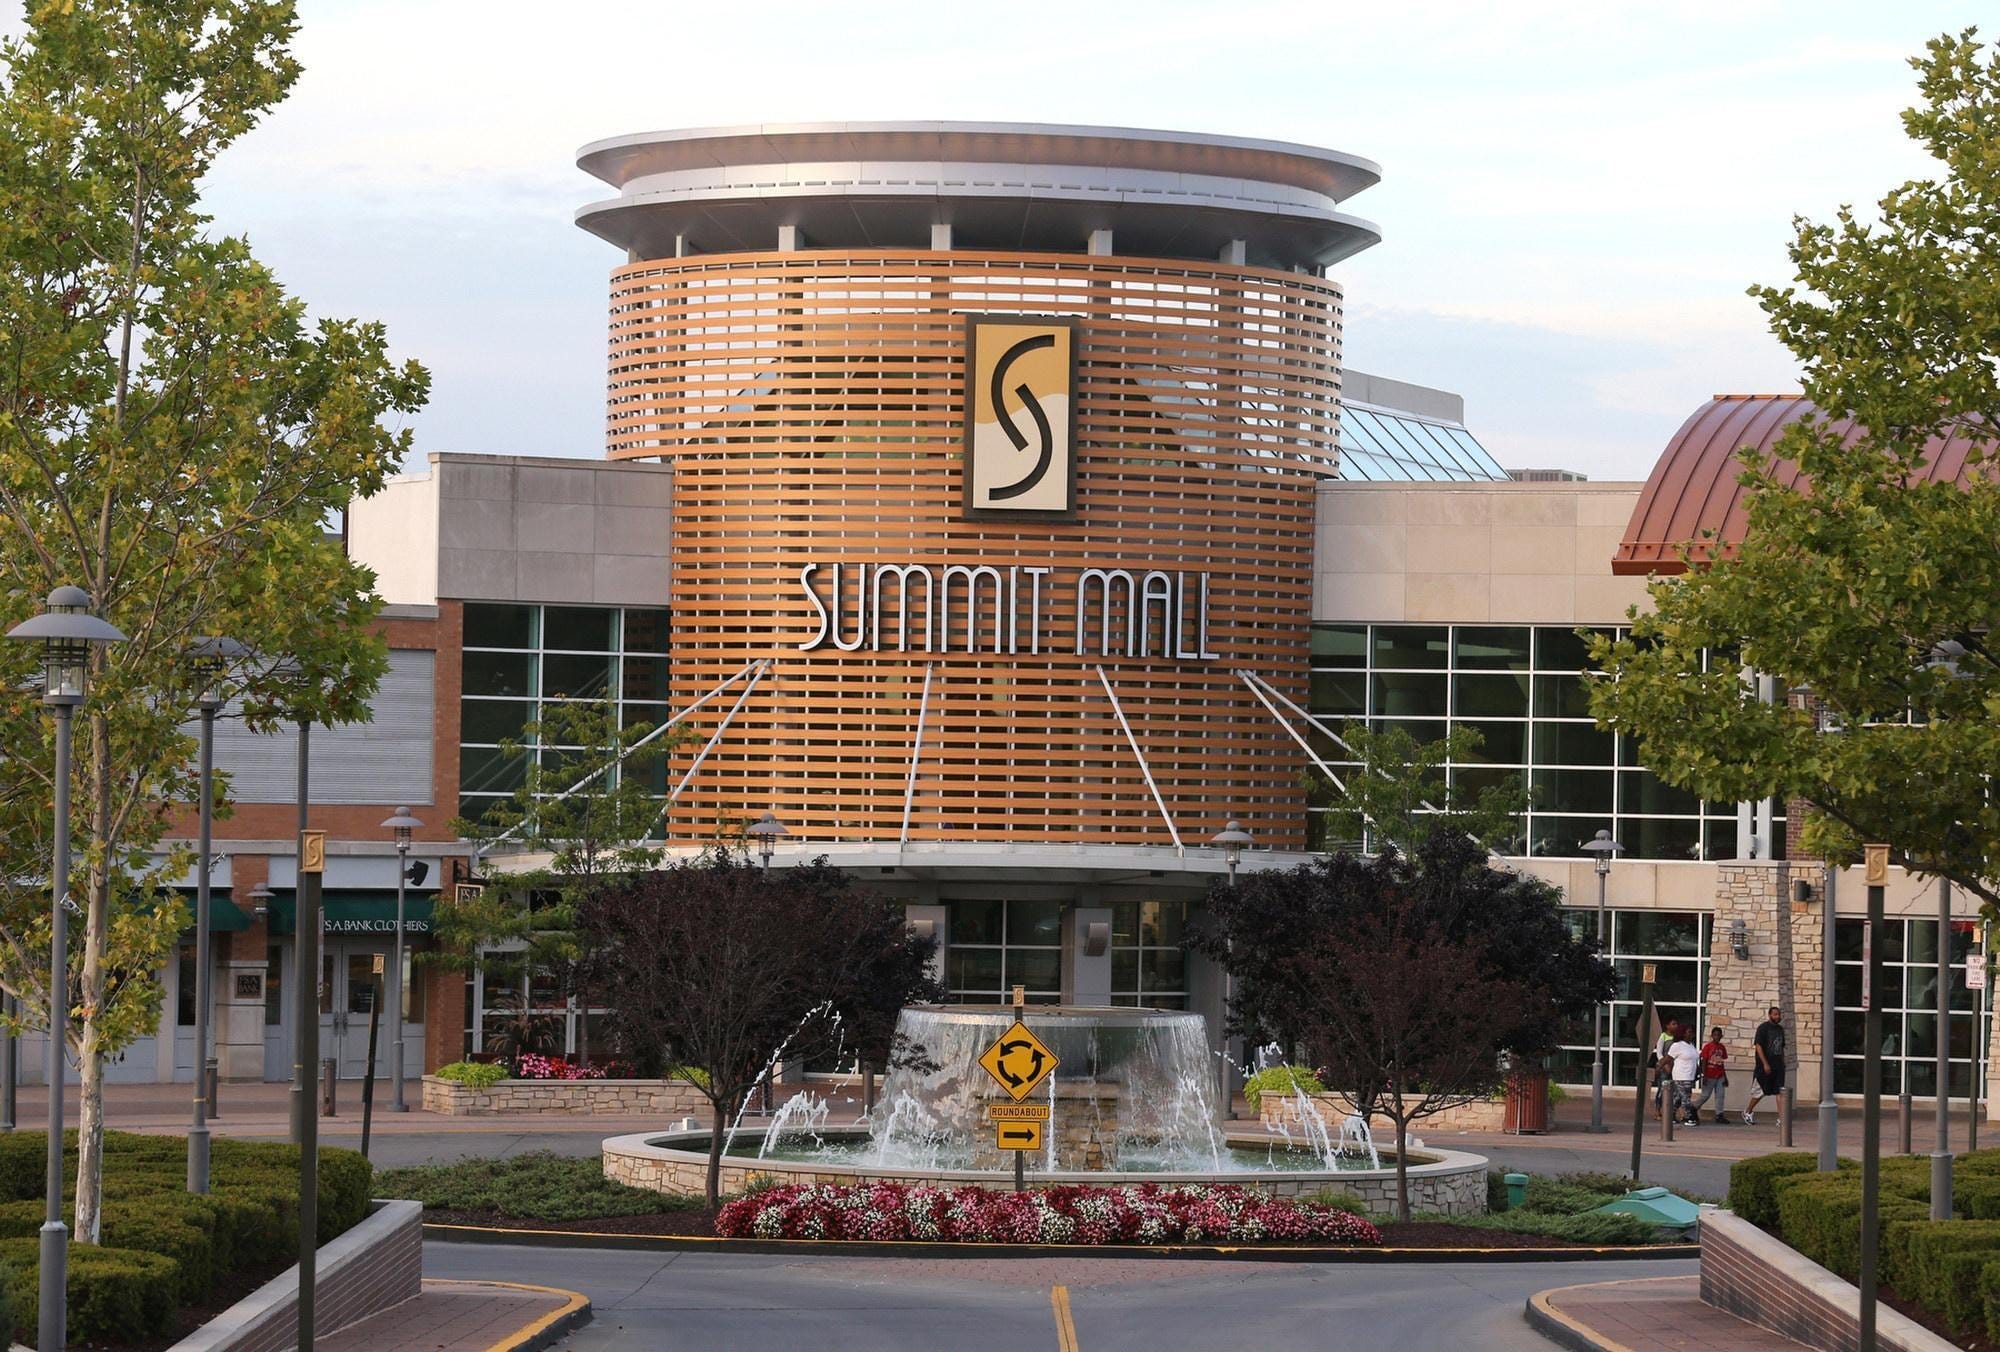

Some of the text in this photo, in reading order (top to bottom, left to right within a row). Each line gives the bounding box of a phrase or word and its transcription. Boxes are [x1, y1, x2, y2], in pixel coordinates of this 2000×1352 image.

[799, 563, 1220, 659] SUMMIT MALL
[344, 919, 373, 931] BANK
[991, 1107, 1047, 1117] ROUNDABOUT
